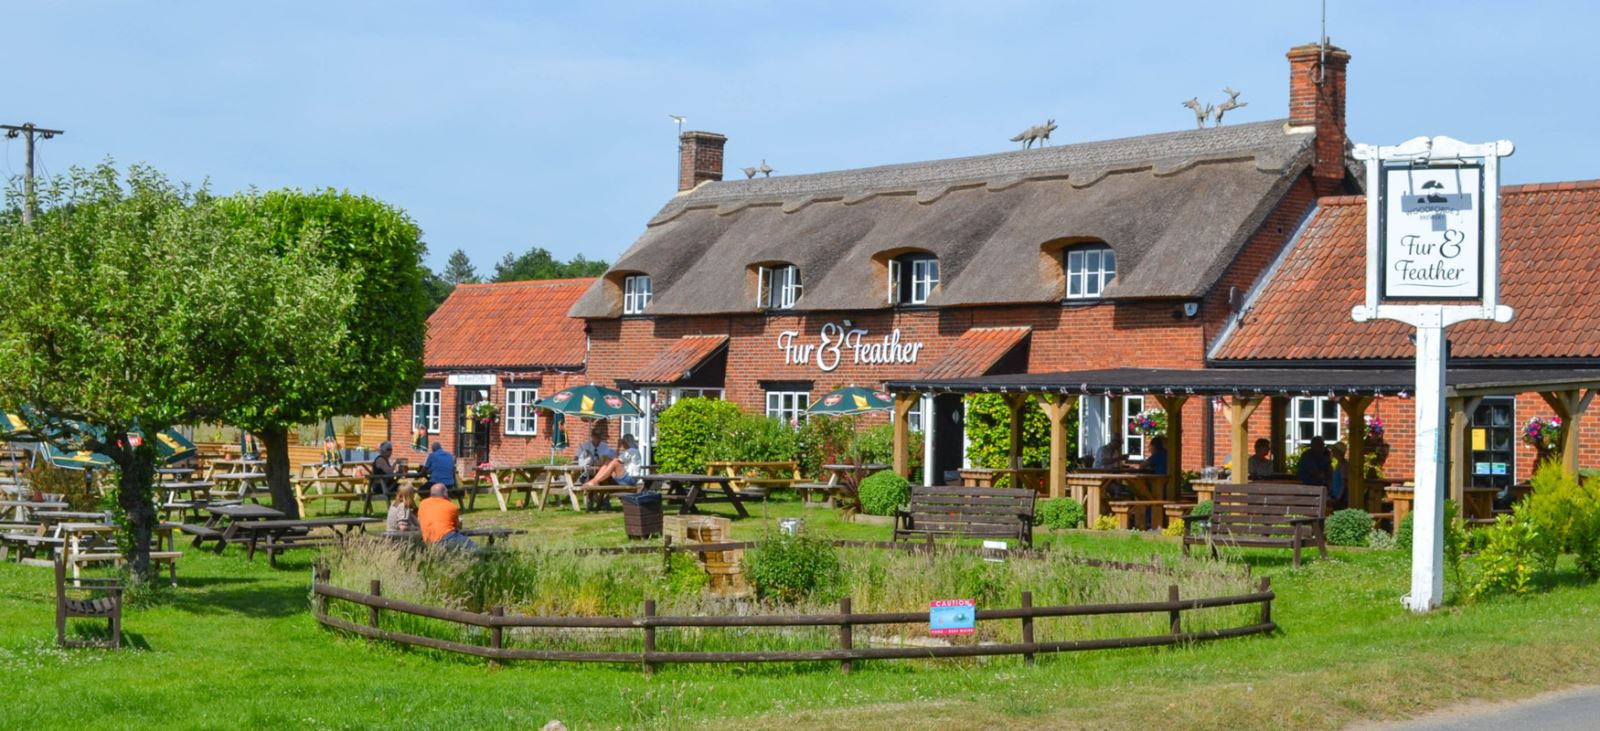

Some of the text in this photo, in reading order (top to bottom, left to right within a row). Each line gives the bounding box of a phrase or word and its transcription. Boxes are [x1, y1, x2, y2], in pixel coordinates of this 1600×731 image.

[1400, 228, 1465, 259] Fur &
[1394, 259, 1465, 281] Feather
[777, 322, 924, 372] Fur & Feather
[935, 599, 971, 607] CAUTION
